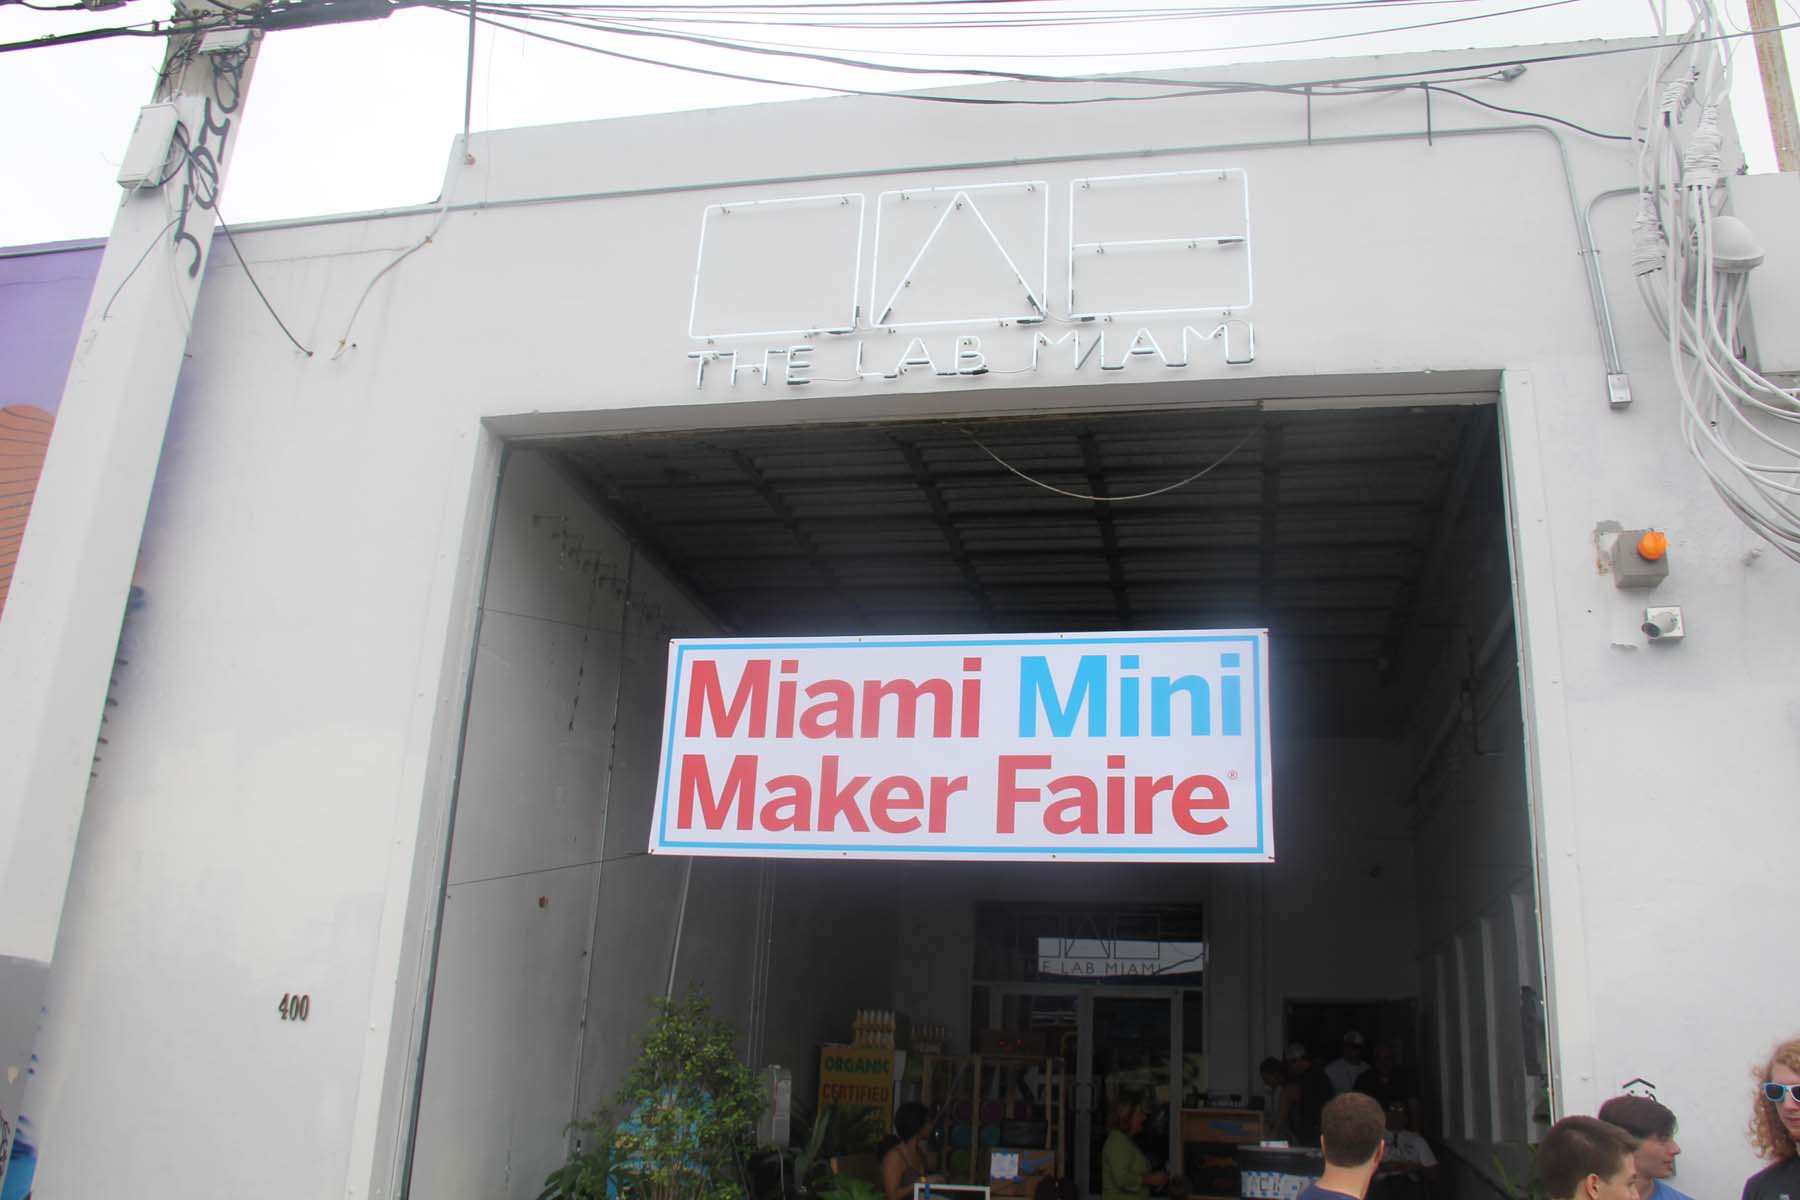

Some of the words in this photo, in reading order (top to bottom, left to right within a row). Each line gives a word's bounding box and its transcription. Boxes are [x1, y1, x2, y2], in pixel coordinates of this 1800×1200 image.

[688, 345, 815, 390] THE
[856, 336, 988, 379] LAB
[1032, 321, 1254, 371] MIAMI
[685, 657, 982, 738] Miami
[1018, 652, 1243, 738] Mini
[677, 753, 968, 835] Maker
[996, 754, 1230, 836] Faire
[1060, 961, 1096, 975] LAB
[1104, 962, 1161, 976] MIAMI
[278, 993, 311, 1022] 400
[822, 1083, 889, 1104] CERTIFIED
